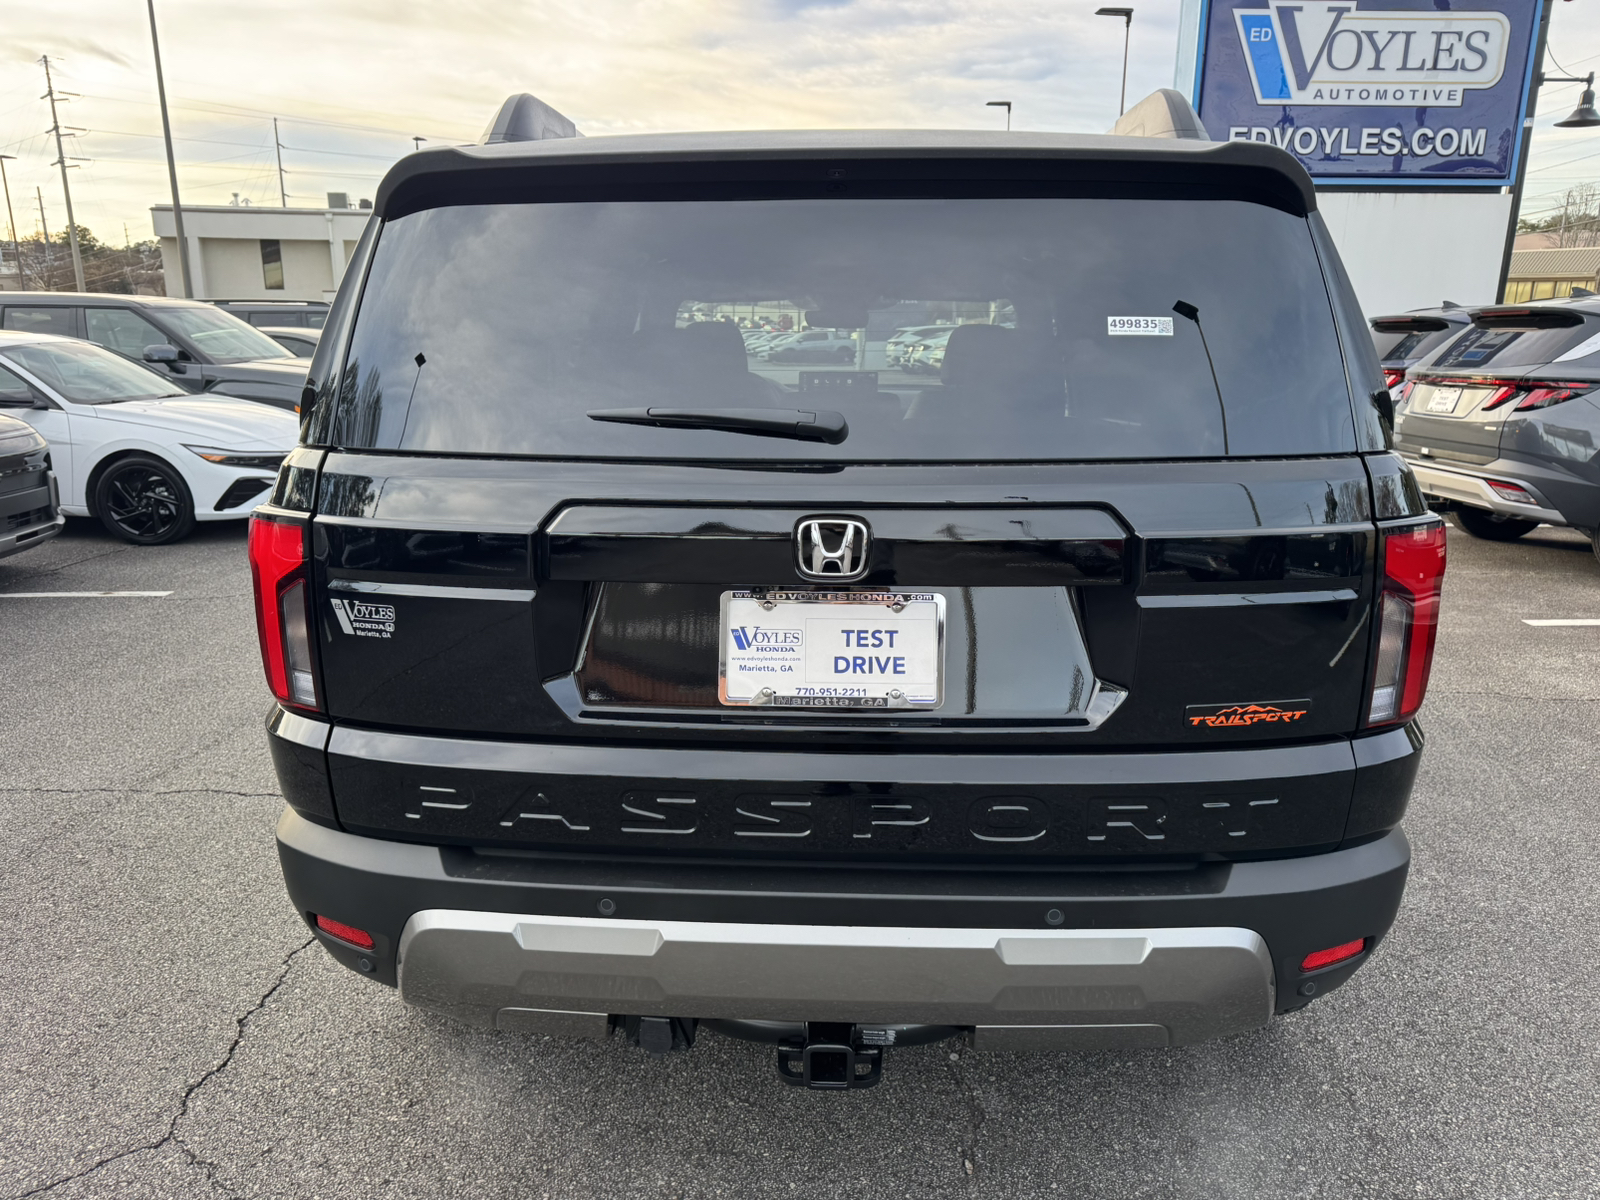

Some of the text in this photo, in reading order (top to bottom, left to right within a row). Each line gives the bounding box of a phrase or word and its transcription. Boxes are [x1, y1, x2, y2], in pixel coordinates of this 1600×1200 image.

[1250, 6, 1490, 91] ED VOYLES
[1313, 88, 1458, 101] AUTOMOTIVE
[1229, 127, 1487, 156] EDVOYLES.COM
[1110, 319, 1158, 329] 499835
[342, 599, 394, 621] VOYLES
[352, 622, 386, 630] HONDA
[739, 626, 800, 649] VOYLES
[841, 629, 899, 648] TEST
[739, 664, 794, 673] Marietta, GA
[834, 656, 906, 674] DRIVE
[795, 687, 867, 697] 770-951-2211
[775, 696, 886, 708] Marietta, GA
[1189, 710, 1307, 727] TRAILSPORT
[404, 784, 1280, 839] PASSPORT
